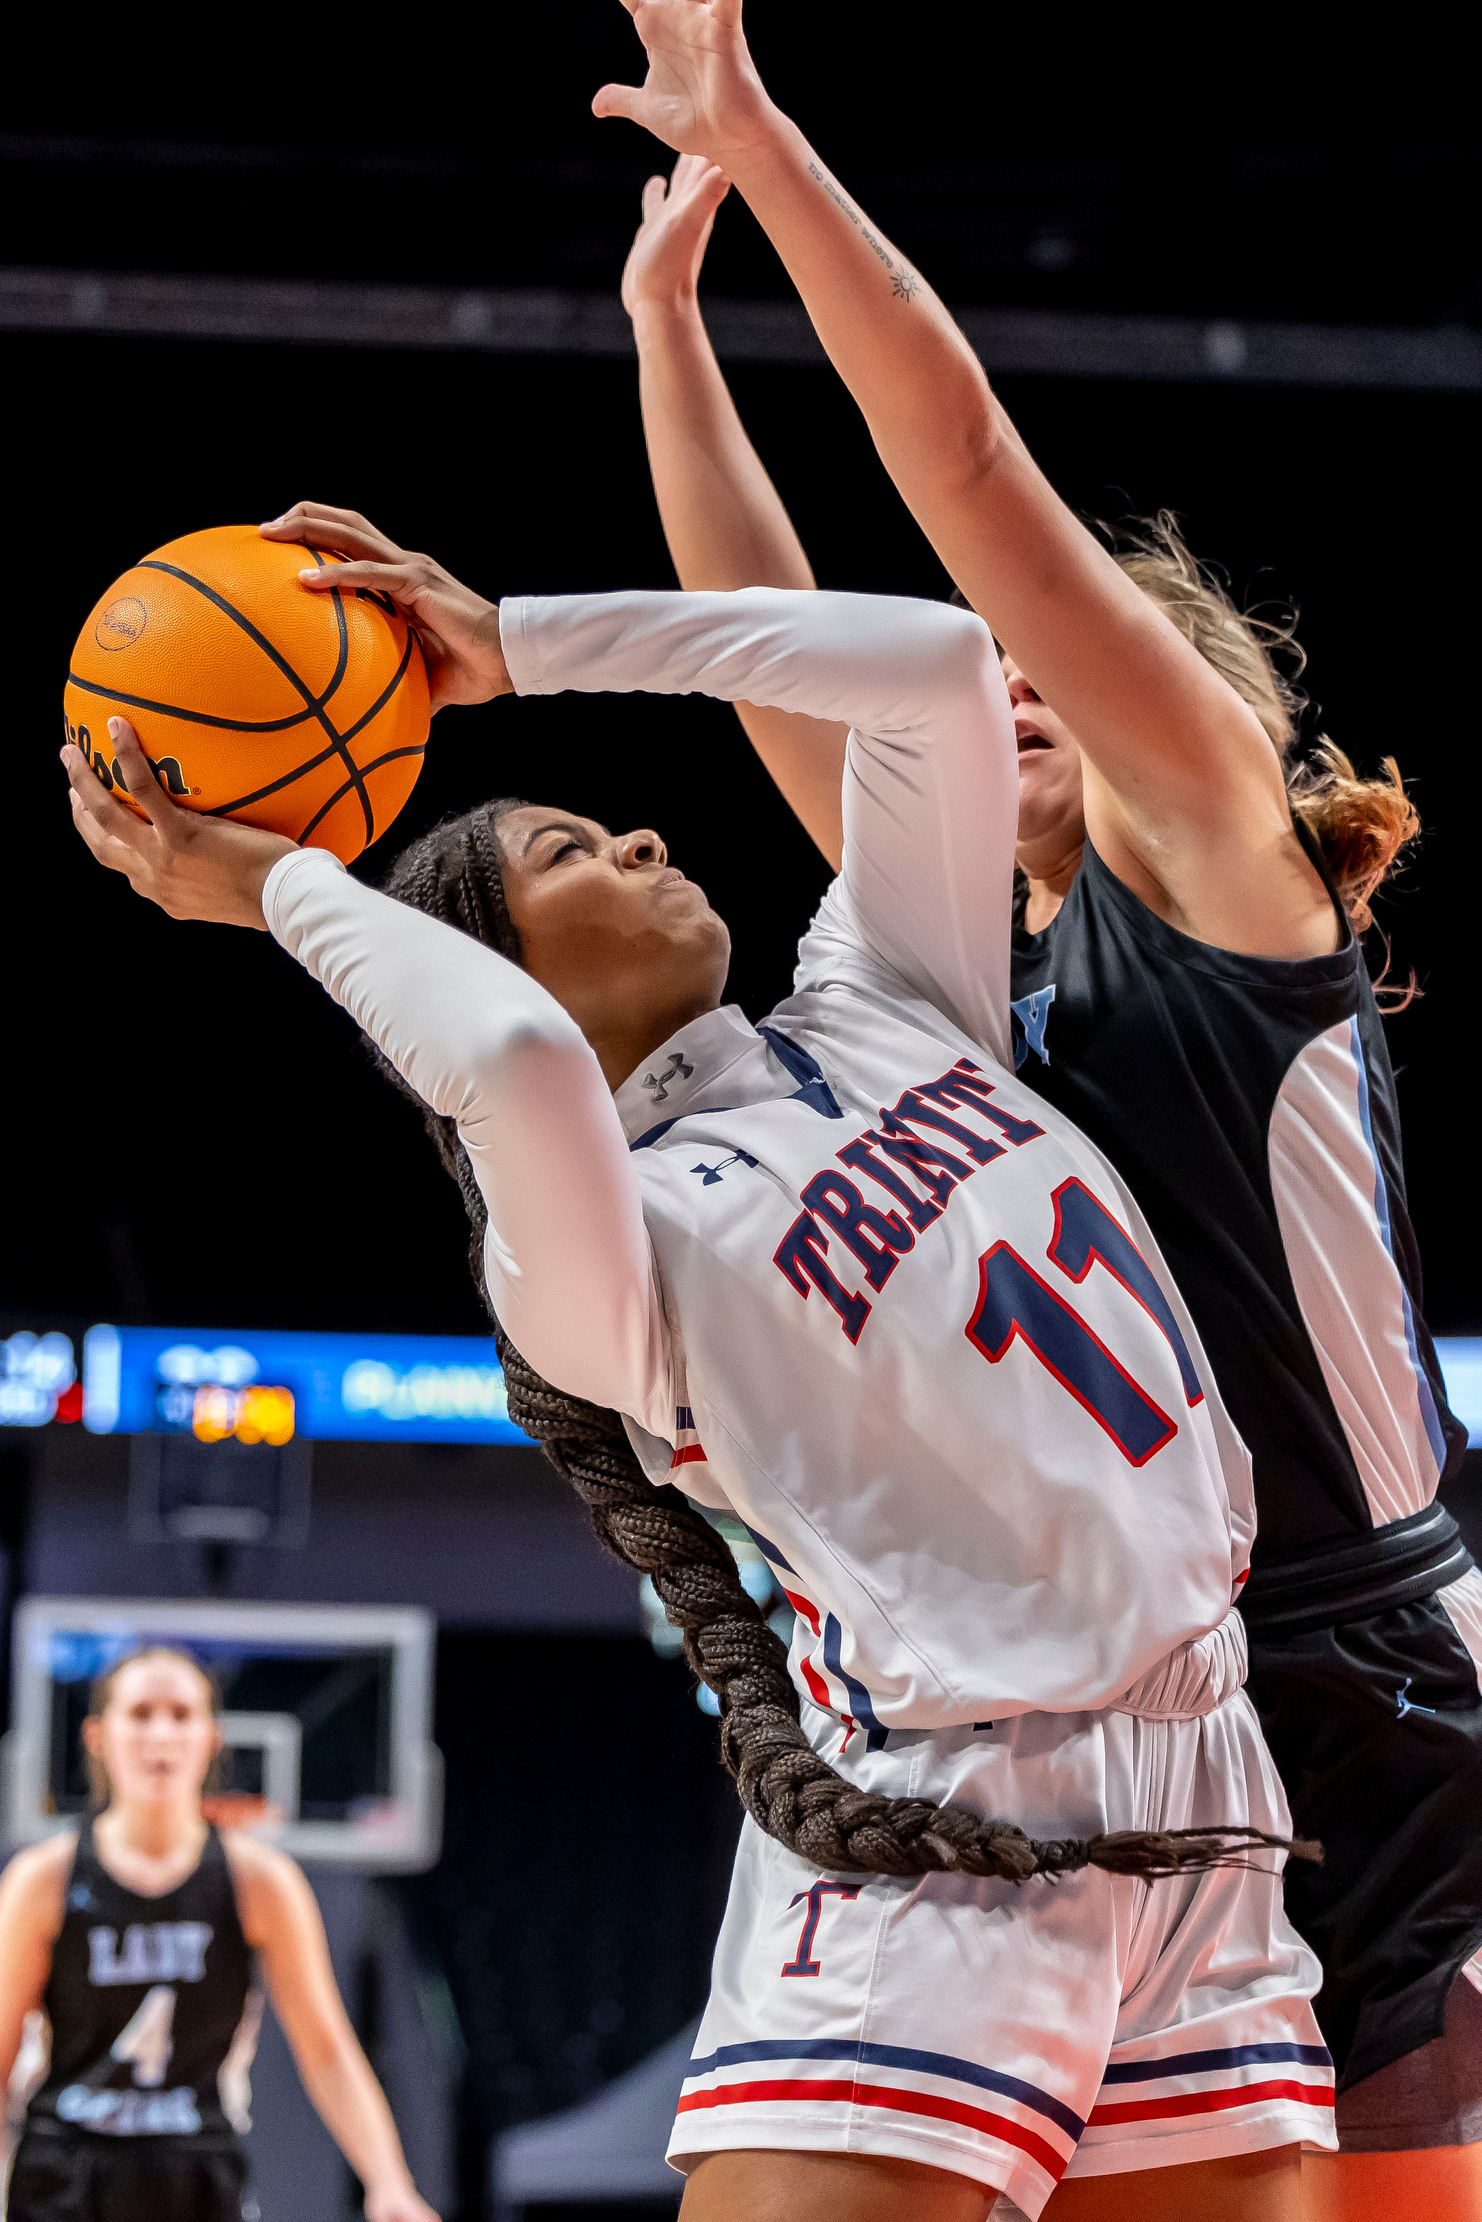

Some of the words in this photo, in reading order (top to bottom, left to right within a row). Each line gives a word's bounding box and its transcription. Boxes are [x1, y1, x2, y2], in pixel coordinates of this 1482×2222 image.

[862, 227, 894, 269] where
[64, 710, 192, 797] lson
[772, 1056, 1047, 1346] TRINIT
[964, 1176, 1205, 1468] 11
[780, 1880, 864, 1976] T
[110, 1984, 177, 2086] 4
